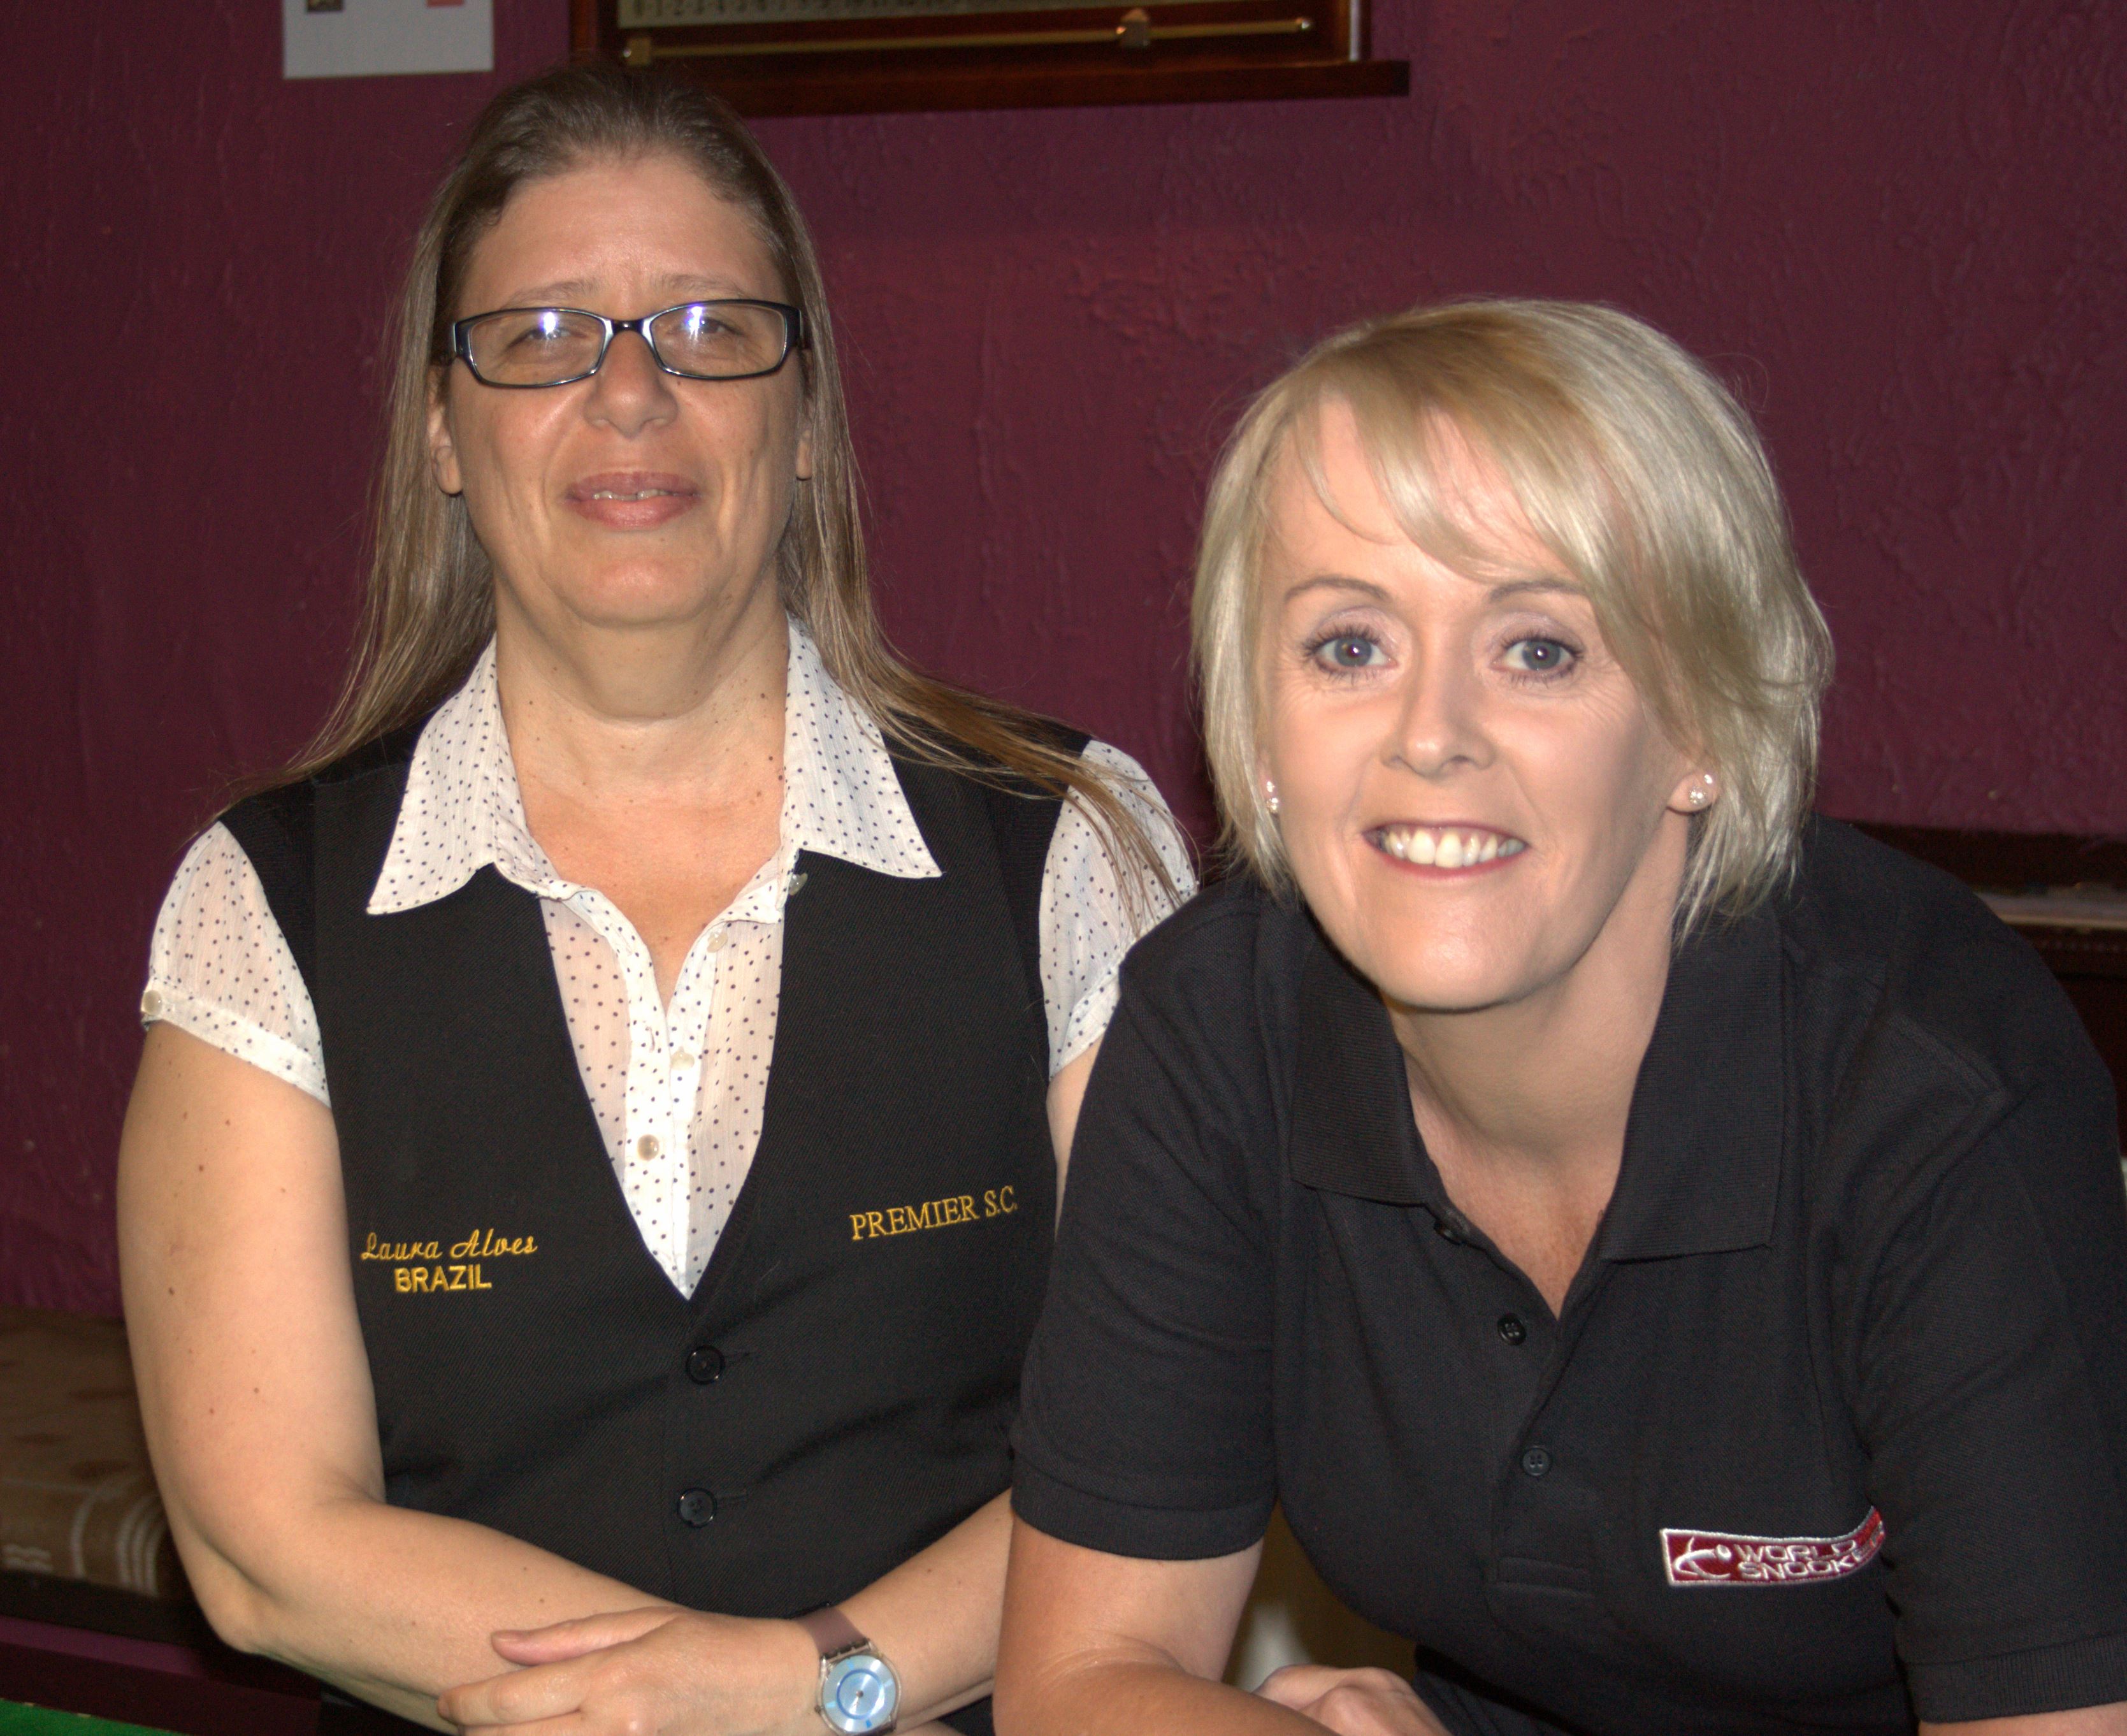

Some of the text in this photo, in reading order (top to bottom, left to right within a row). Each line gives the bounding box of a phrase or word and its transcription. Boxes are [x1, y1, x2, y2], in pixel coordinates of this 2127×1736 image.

[849, 1195, 981, 1241] PREMIER
[360, 1227, 538, 1261] Laura Alves
[393, 1263, 493, 1293] BRAZIL
[1733, 1539, 1857, 1563] WORLD
